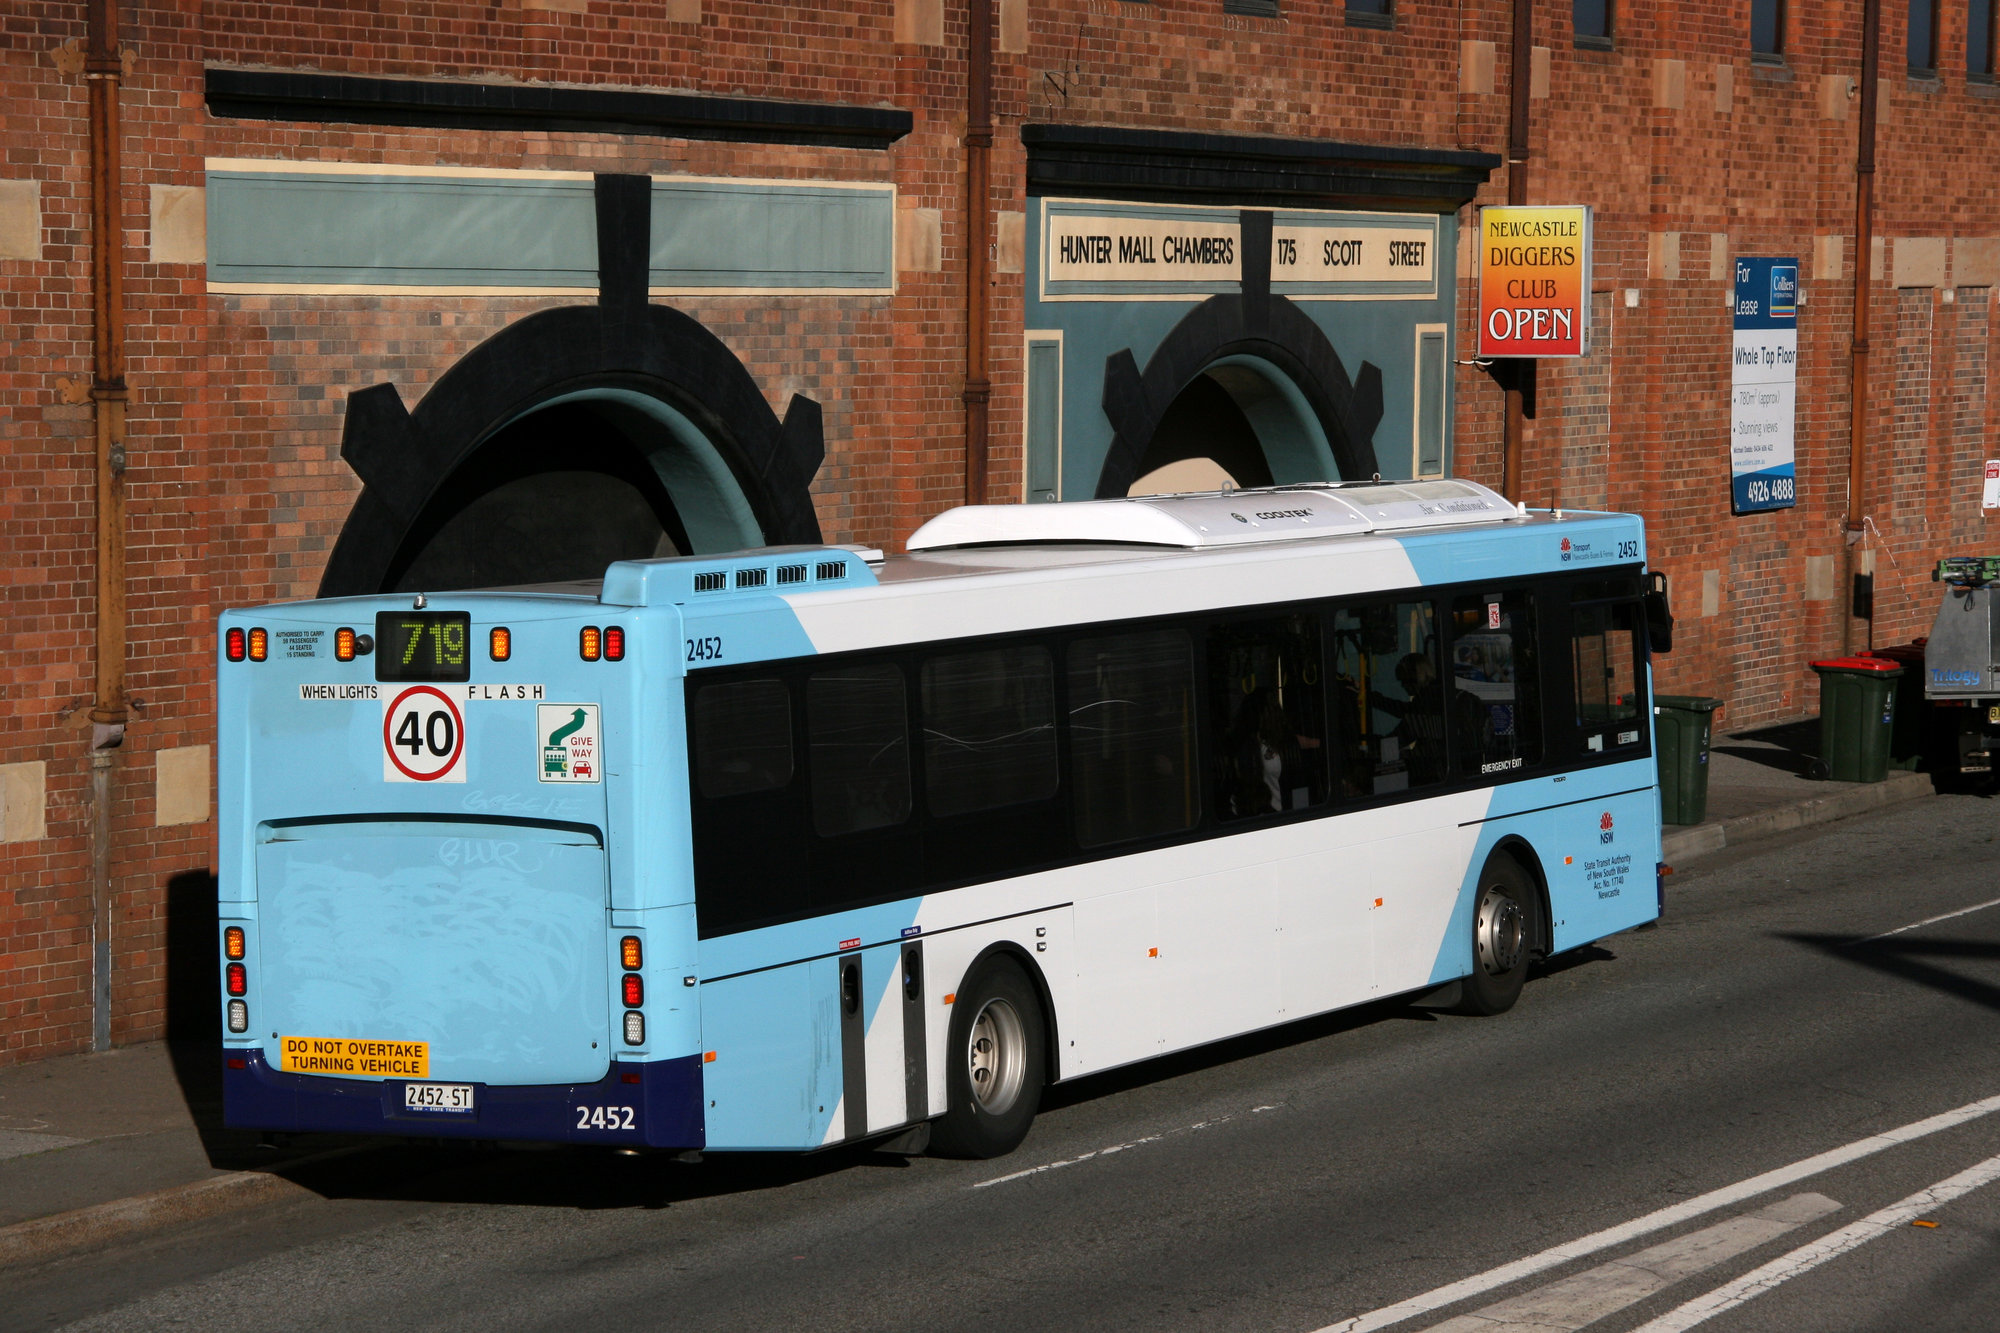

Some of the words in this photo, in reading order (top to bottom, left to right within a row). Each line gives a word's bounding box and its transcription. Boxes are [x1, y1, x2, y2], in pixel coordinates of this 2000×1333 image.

[1490, 221, 1577, 237] NEWCASTLE
[1060, 235, 1111, 264] HUNTER
[1119, 236, 1156, 264] MALL
[1163, 236, 1234, 265] CHAMBERS
[1277, 239, 1296, 265] 175
[1323, 240, 1363, 266] SCOTT
[1389, 240, 1426, 267] STREET
[1490, 247, 1575, 266] DIGGERS
[1736, 262, 1750, 283] For
[1507, 279, 1557, 299] CLUB
[1773, 276, 1794, 291] Colliers
[1735, 295, 1758, 315] Lease
[1488, 307, 1573, 341] OPEN
[1735, 347, 1758, 365] Whole
[1761, 346, 1774, 369] Top
[1777, 346, 1796, 364] Floor
[1739, 420, 1761, 437] Stunning
[1763, 422, 1778, 433] views
[1748, 480, 1769, 502] 4926
[1772, 478, 1793, 500] 4888
[1561, 553, 1571, 561] NSW
[1618, 541, 1638, 558] 2452
[401, 624, 464, 664] 719
[686, 636, 722, 661] 2452
[1929, 668, 1980, 686] Trilogy
[302, 686, 335, 699] WHEN
[339, 686, 378, 699] LIGHTS
[395, 710, 454, 757] 40
[570, 737, 593, 746] GIVE
[571, 749, 592, 757] WAY
[1481, 760, 1511, 774] EMERGENCY
[1511, 757, 1522, 768] EXIT
[1600, 832, 1614, 845] NSW
[1584, 861, 1596, 870] State
[1596, 858, 1611, 868] Transit
[1611, 853, 1631, 865] Authority
[1587, 871, 1592, 880] of
[1592, 871, 1603, 880] New
[1603, 867, 1616, 877] South
[1616, 865, 1630, 874] Wales
[1598, 887, 1620, 899] Newcastle
[288, 1040, 308, 1052] DO
[314, 1041, 342, 1053] NOT
[348, 1042, 422, 1057] OVERTAKE
[291, 1056, 354, 1070] TURNING
[360, 1059, 420, 1073] VEHICLE
[576, 1106, 635, 1130] 2452
